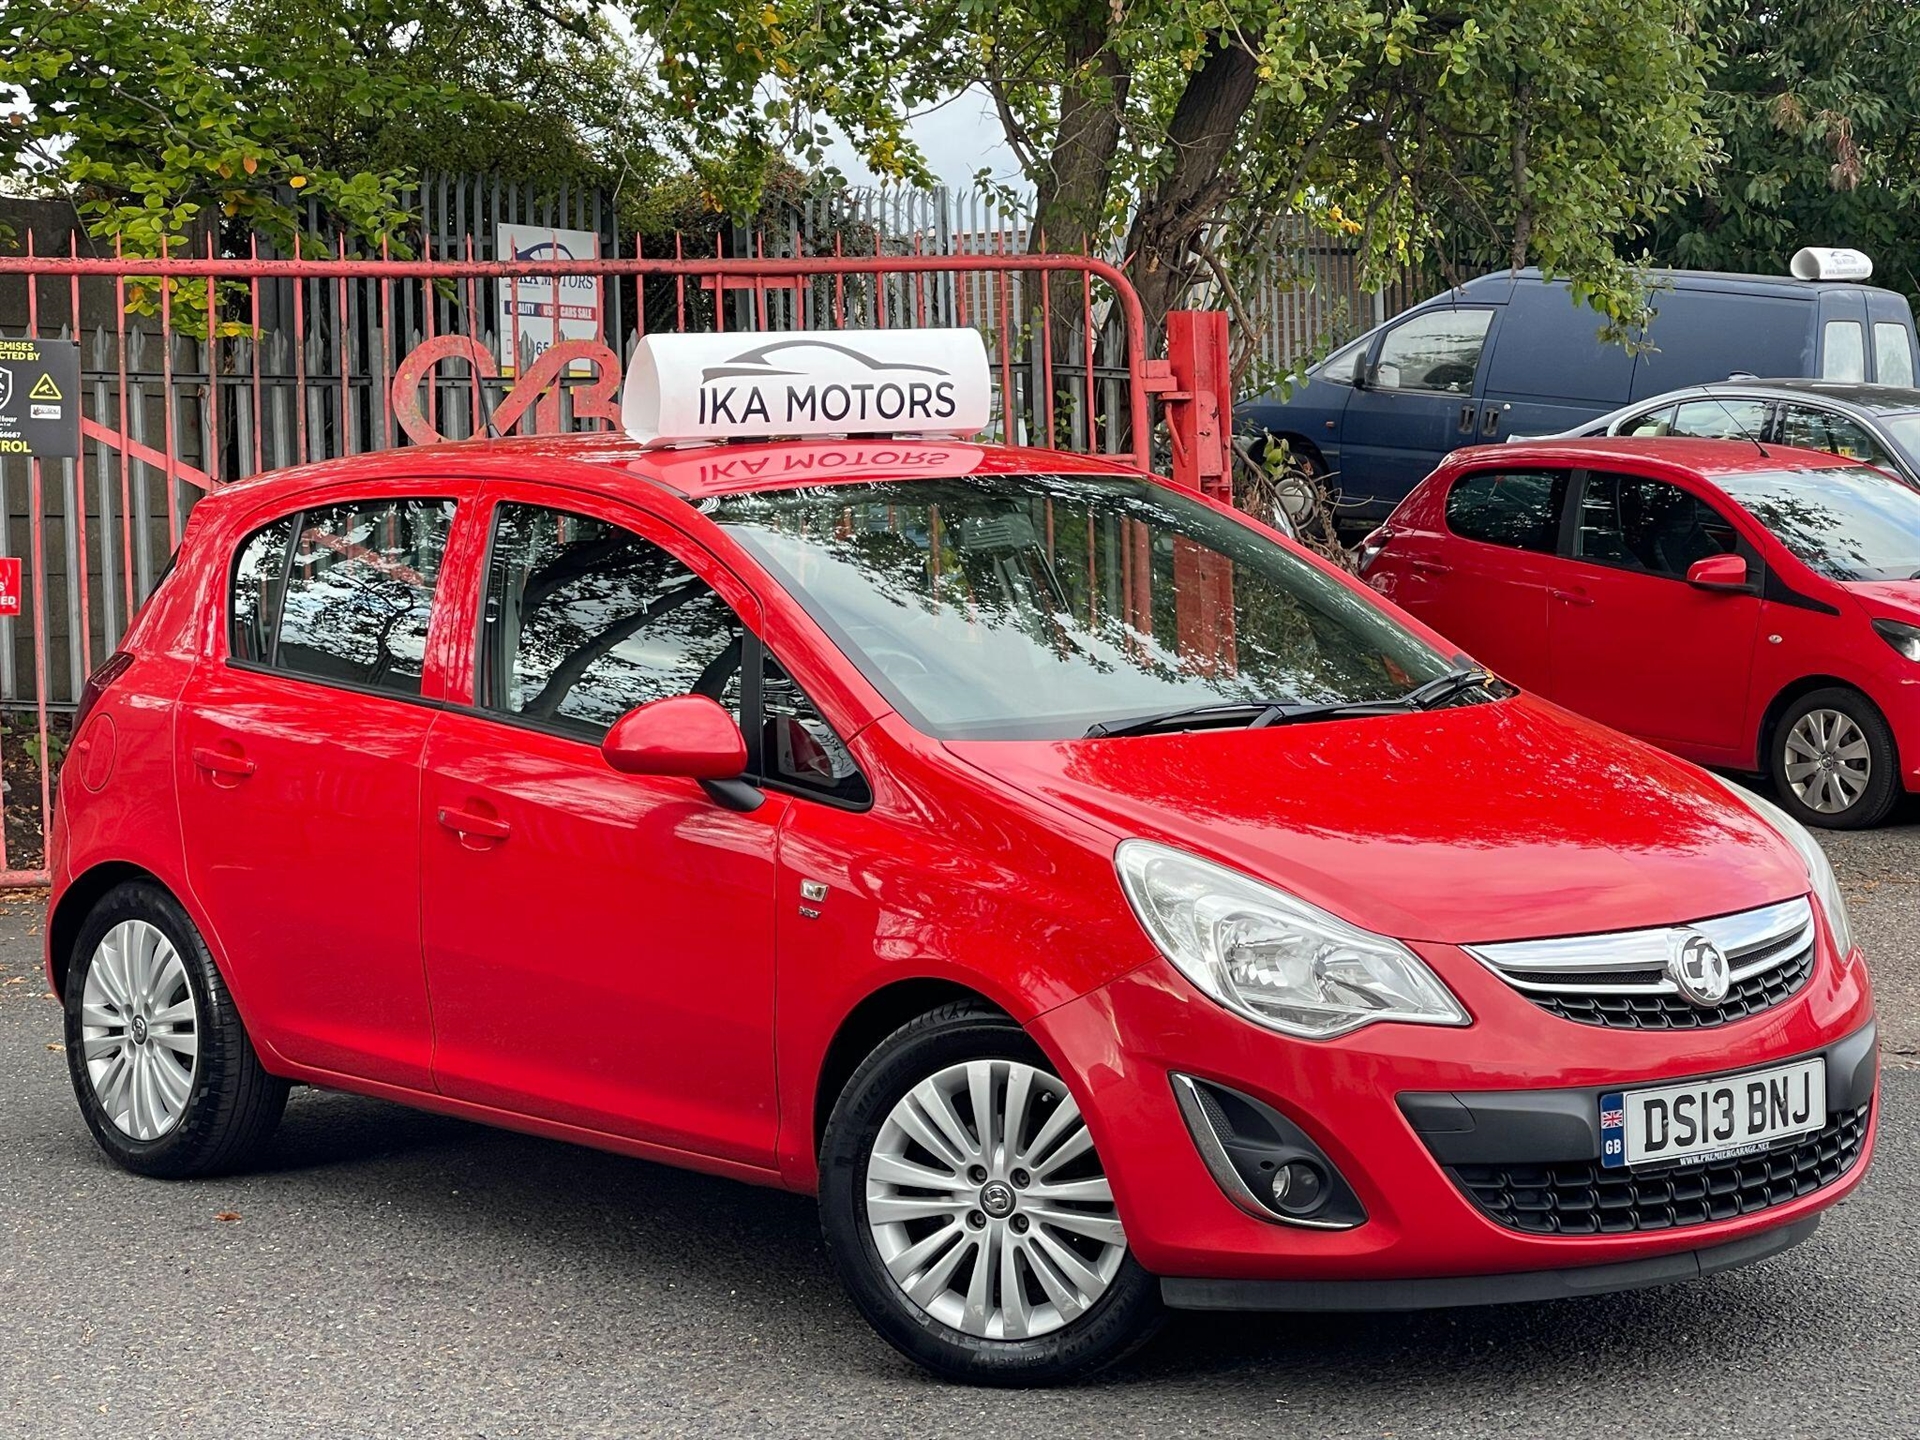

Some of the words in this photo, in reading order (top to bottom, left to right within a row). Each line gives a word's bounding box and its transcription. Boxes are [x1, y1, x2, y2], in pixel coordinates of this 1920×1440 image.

[541, 275, 594, 290] MTORS
[560, 306, 578, 318] CARS
[578, 307, 592, 320] SALE
[27, 352, 41, 361] BY
[698, 386, 771, 425] IKA
[786, 381, 956, 423] MOTORS
[1643, 1088, 1735, 1153] DS13
[1747, 1071, 1810, 1135] BNJ
[1605, 1138, 1622, 1156] GB
[1679, 1141, 1771, 1166] WWW.PREMIERGARAGE.NET
